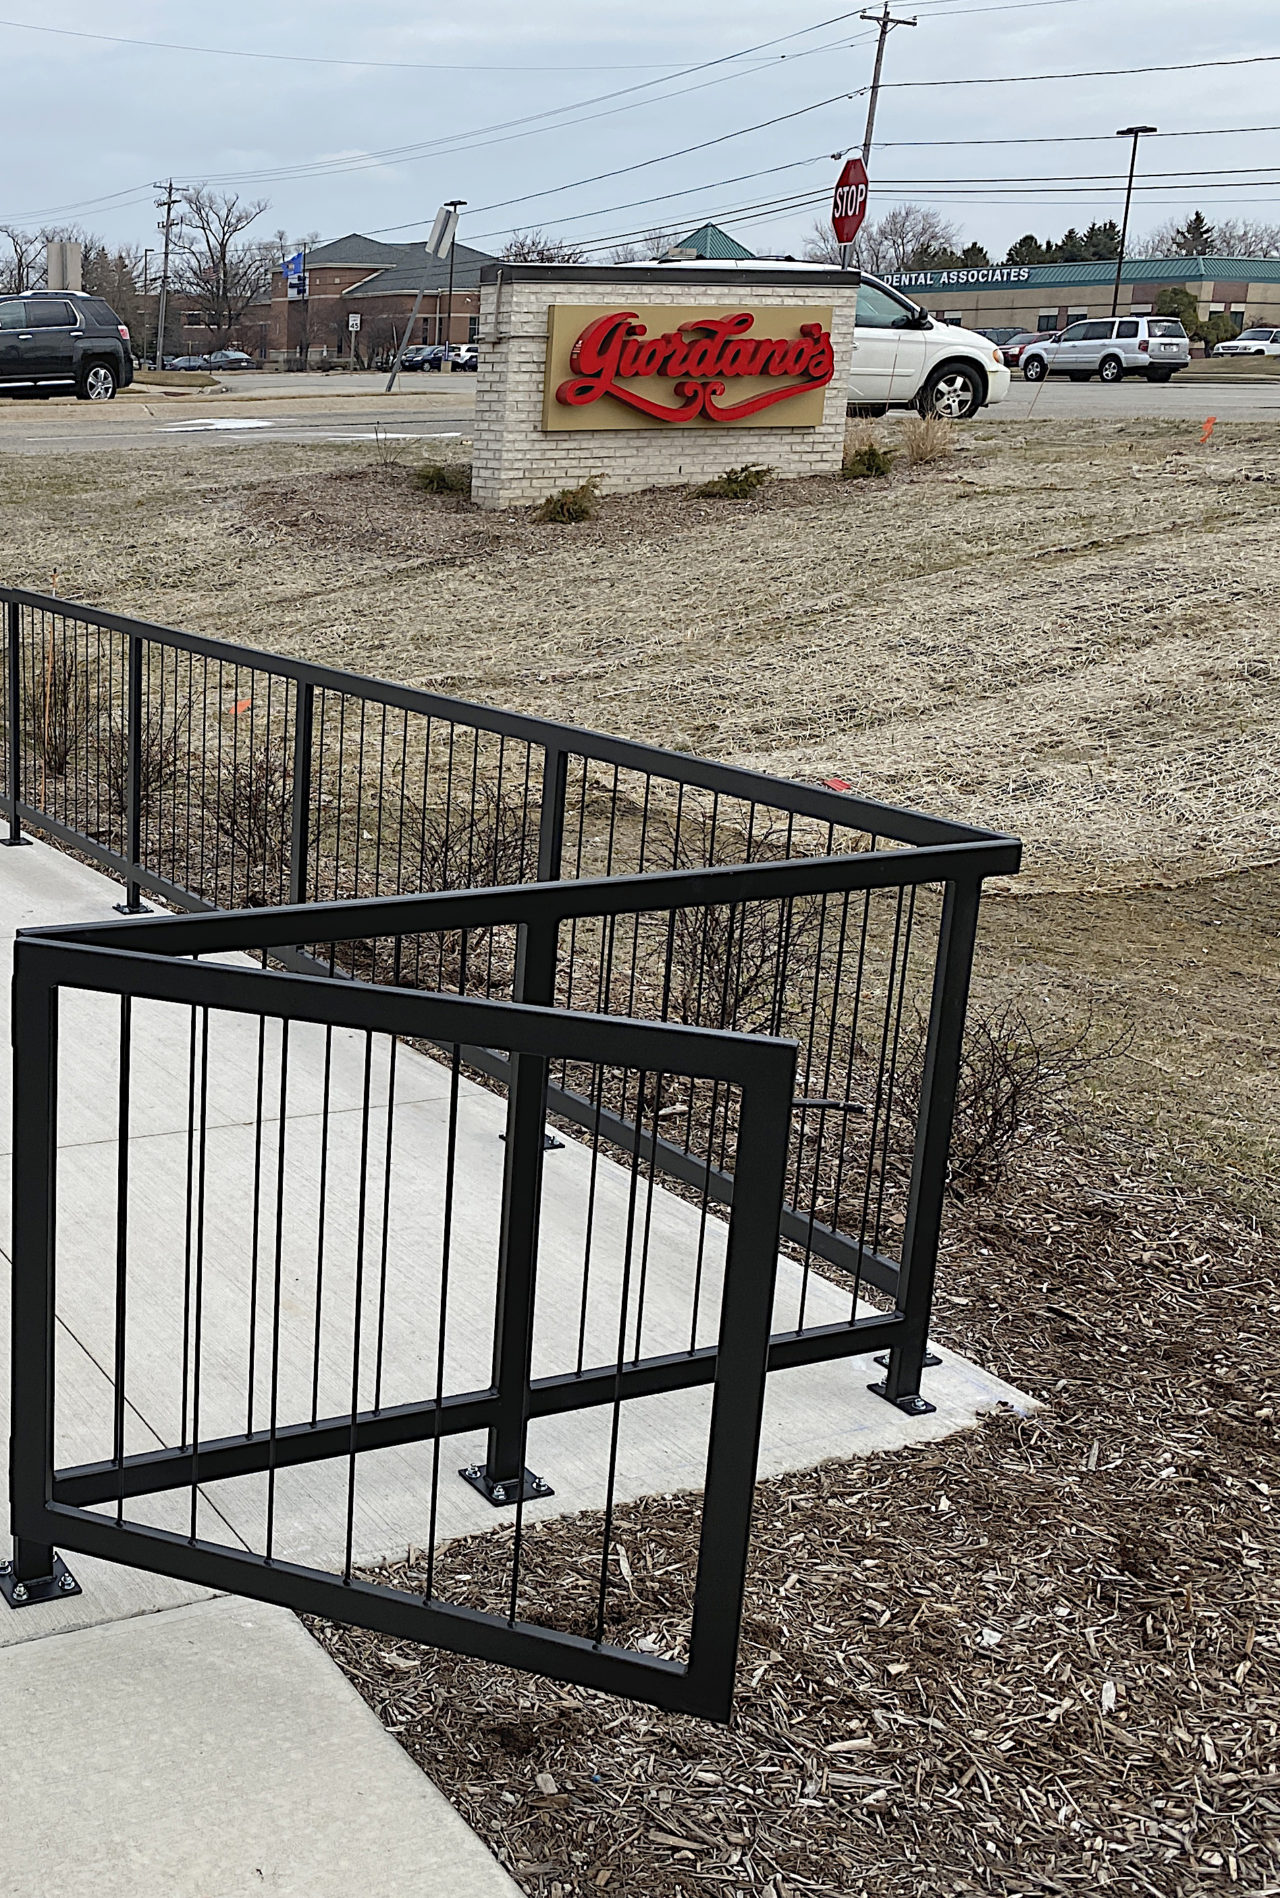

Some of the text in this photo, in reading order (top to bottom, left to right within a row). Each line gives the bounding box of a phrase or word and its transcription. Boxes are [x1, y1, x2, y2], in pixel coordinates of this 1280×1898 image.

[834, 183, 866, 218] STOP
[883, 267, 1029, 287] DENTAL ASSOCIATES
[349, 322, 360, 330] 45
[555, 311, 835, 423] Giordano's
